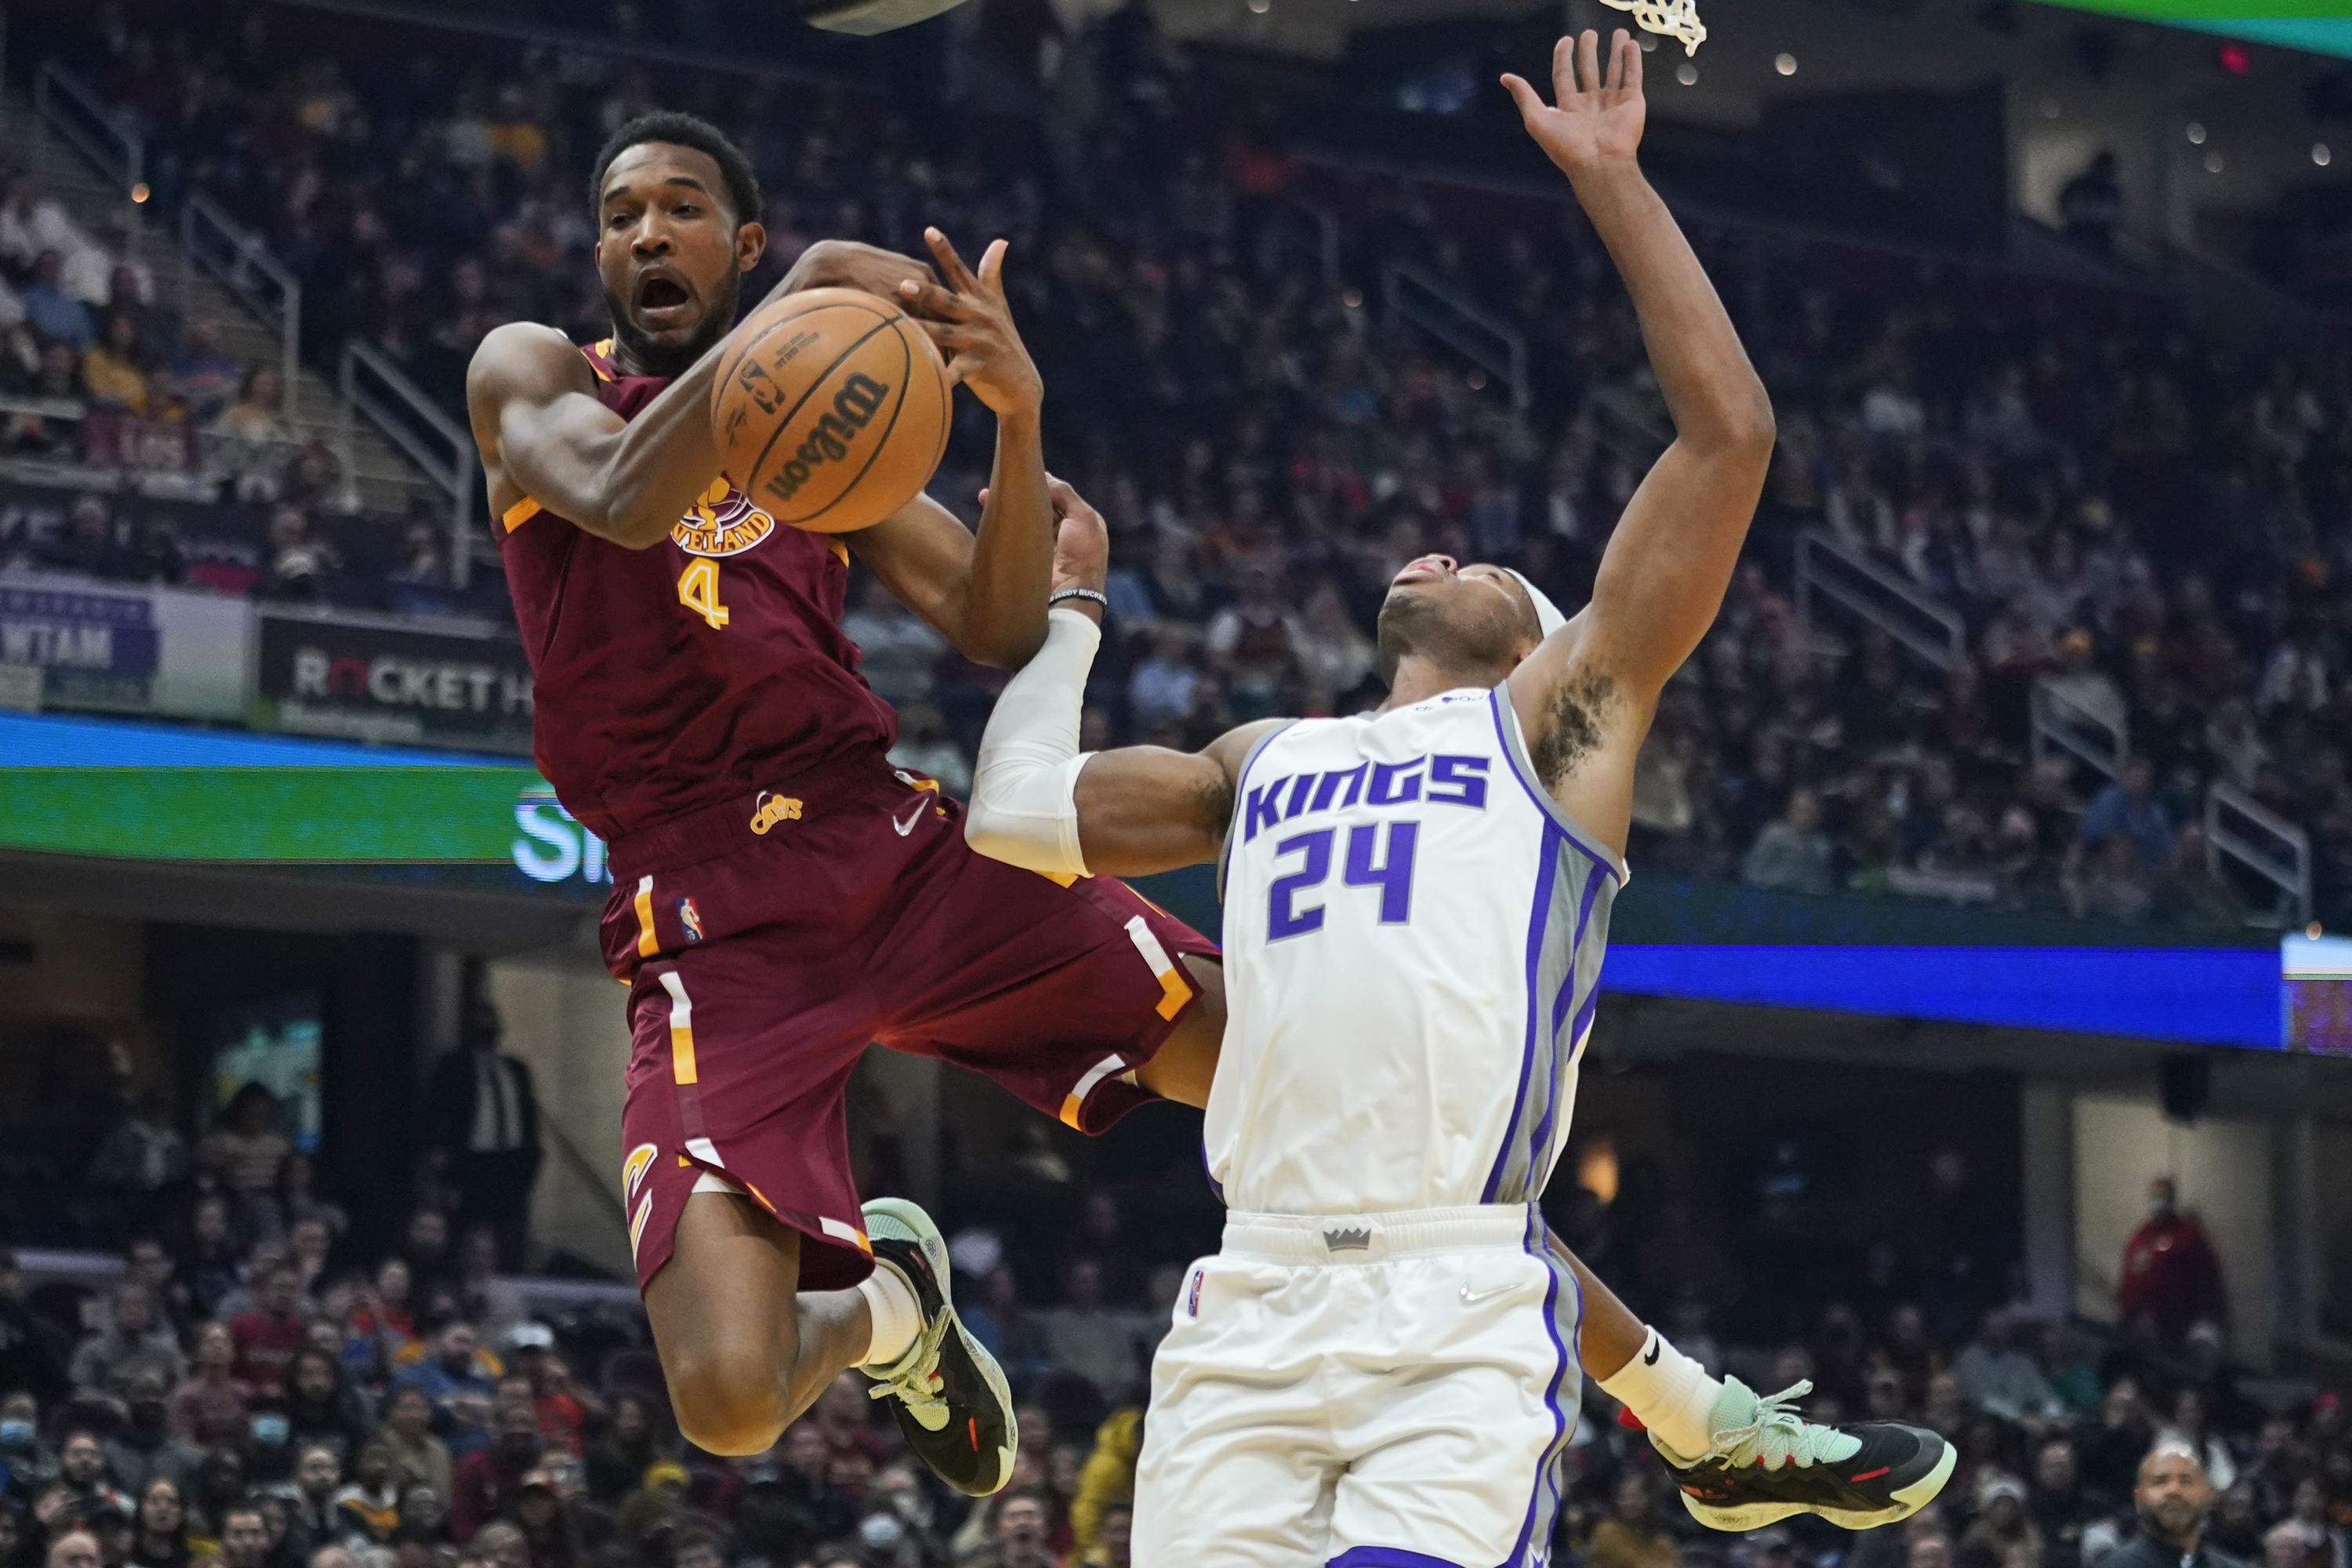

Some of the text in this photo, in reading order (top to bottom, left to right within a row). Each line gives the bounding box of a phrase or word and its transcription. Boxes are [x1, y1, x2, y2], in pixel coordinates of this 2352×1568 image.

[765, 372, 889, 501] Wilson
[673, 511, 771, 553] VELAND
[678, 557, 729, 630] 4
[294, 647, 495, 712] ROCKET
[1243, 753, 1491, 847] KINGS
[1265, 820, 1421, 946] 24
